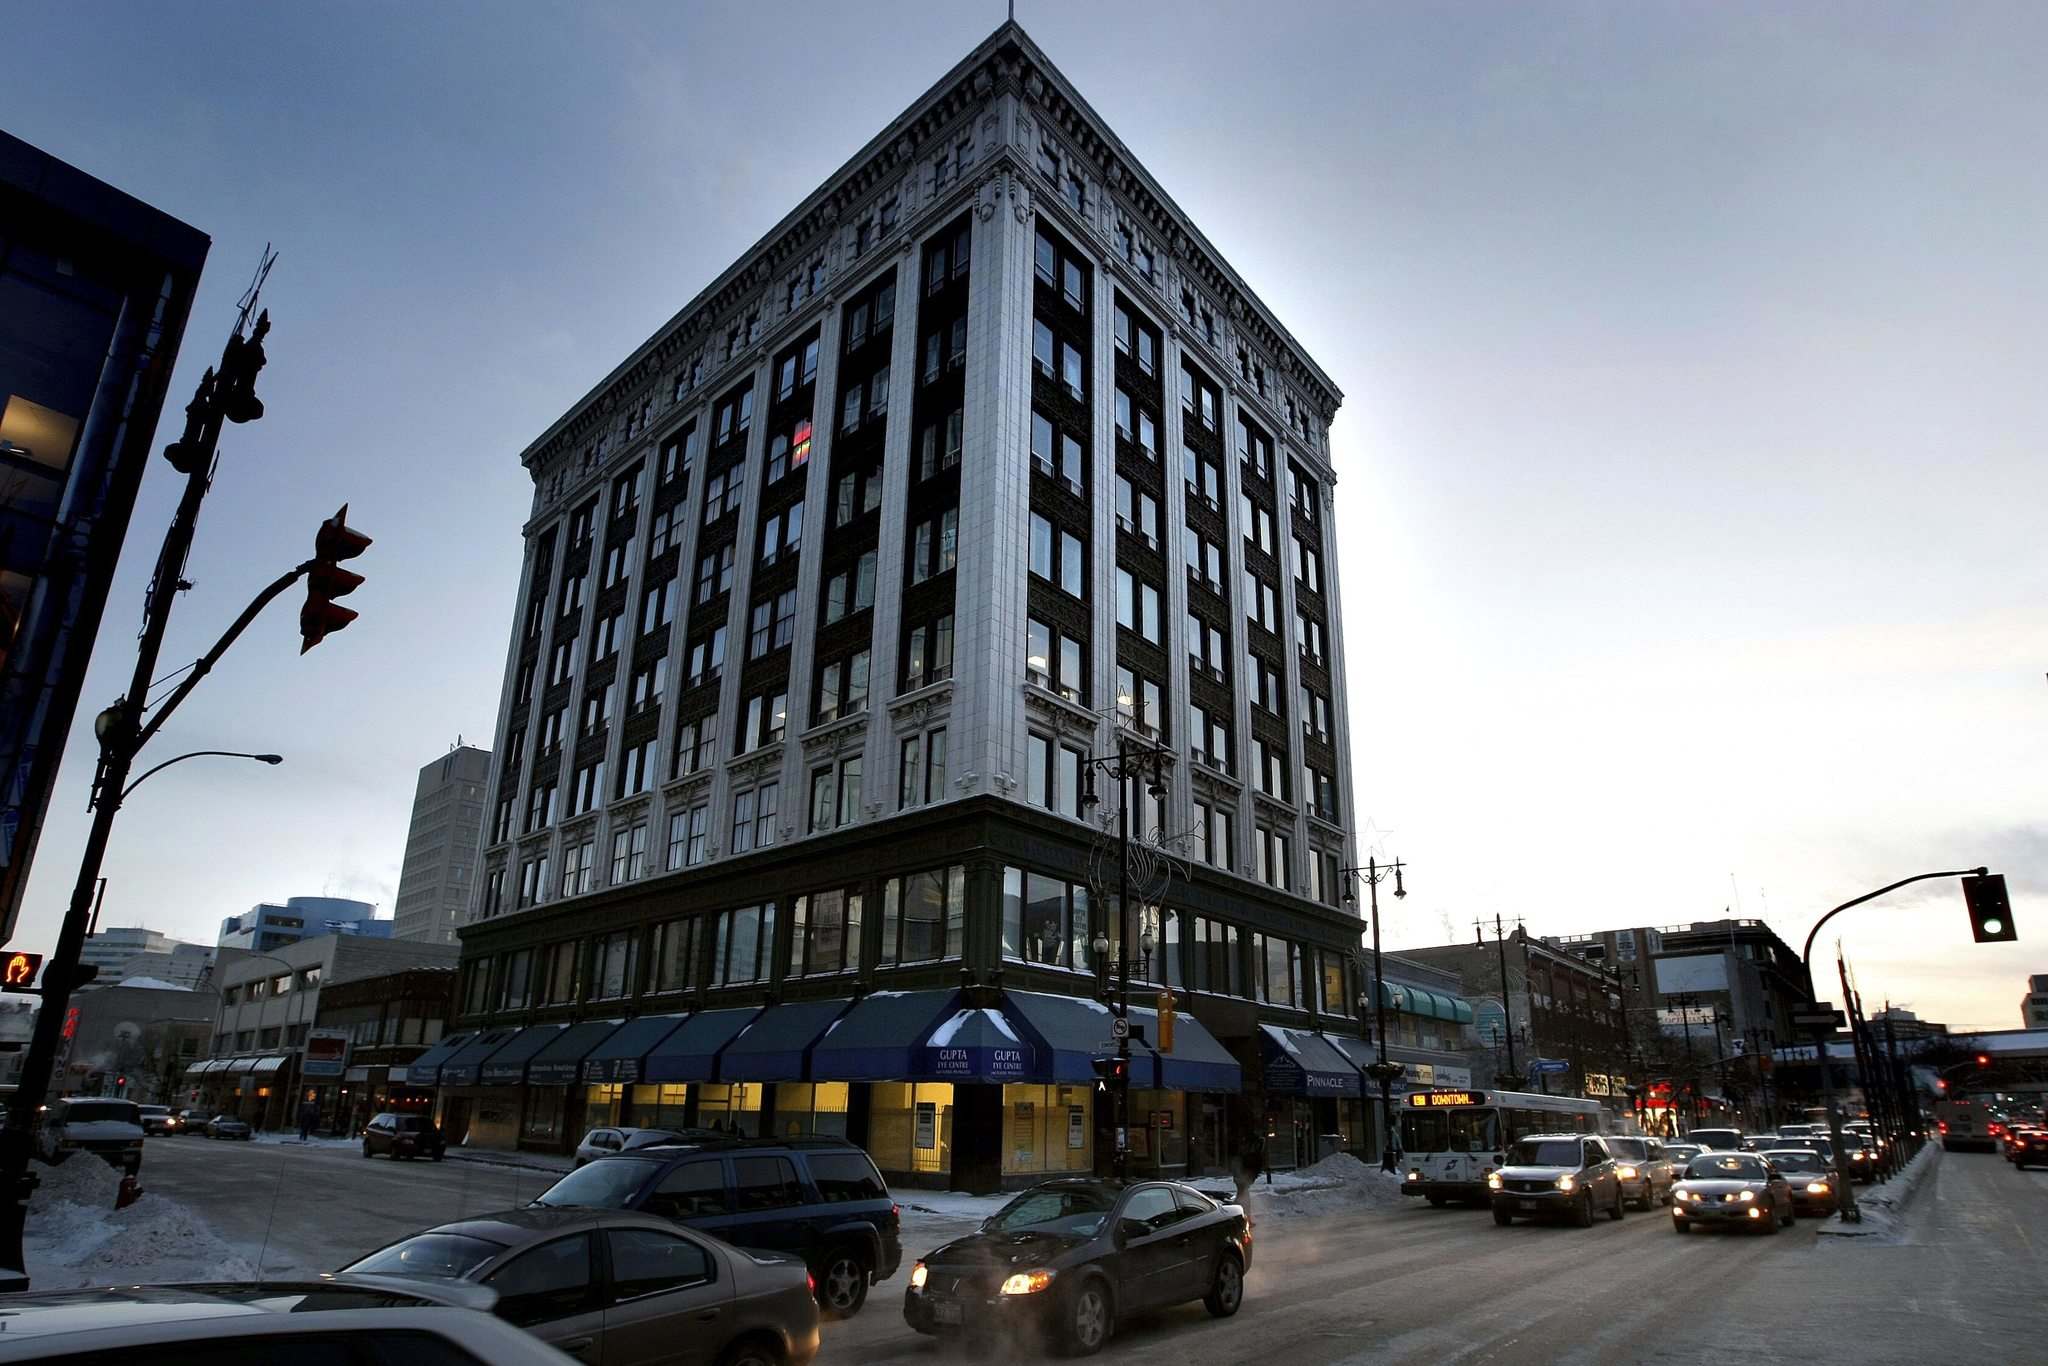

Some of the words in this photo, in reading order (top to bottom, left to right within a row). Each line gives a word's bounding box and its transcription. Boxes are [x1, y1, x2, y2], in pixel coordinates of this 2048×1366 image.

[939, 1049, 968, 1061] GUPTA
[994, 1049, 1021, 1062] GUPTA
[937, 1061, 947, 1069] EYE
[948, 1061, 969, 1069] CENTRE
[992, 1062, 1002, 1070] EYE
[1003, 1062, 1023, 1070] CENTRE
[1306, 1074, 1344, 1089] PINNACLE
